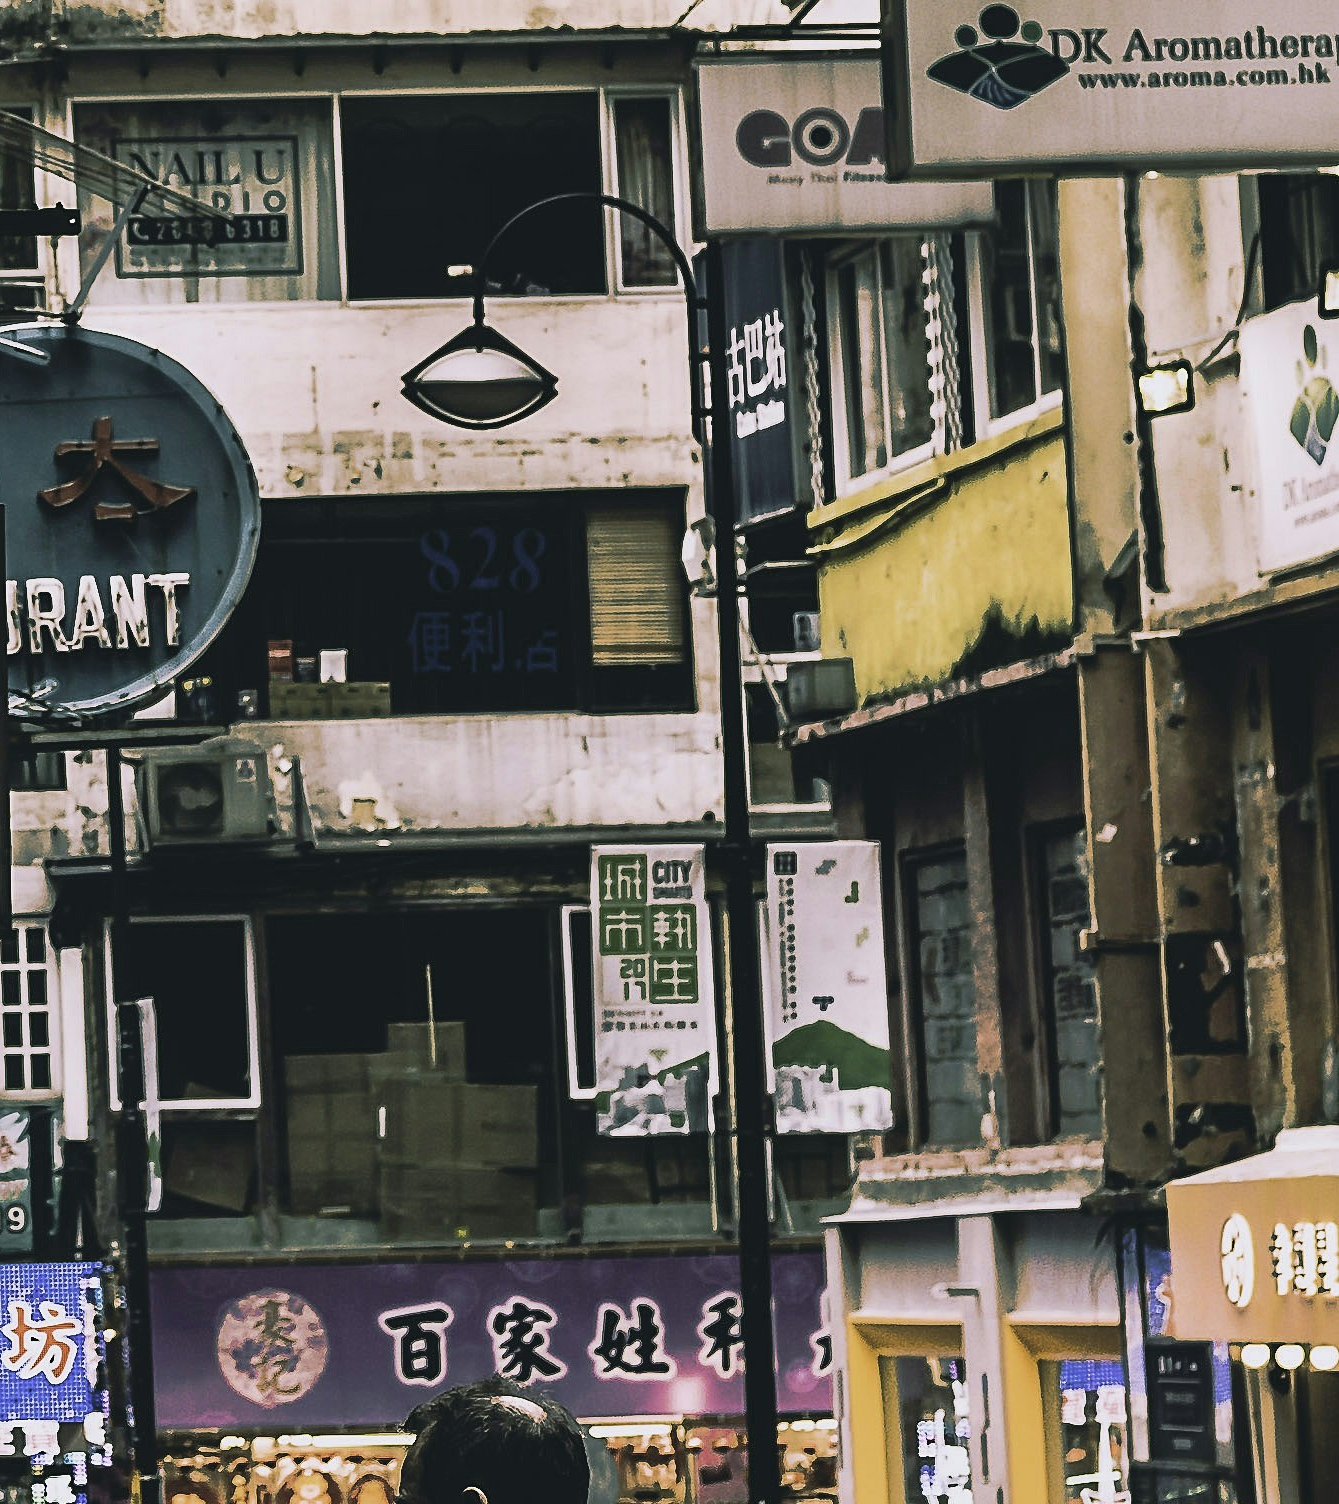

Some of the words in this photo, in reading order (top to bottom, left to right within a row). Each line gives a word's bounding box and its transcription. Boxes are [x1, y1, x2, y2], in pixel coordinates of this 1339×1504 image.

[1050, 28, 1109, 64] DK
[1078, 63, 1331, 90] www.aroma.com.hk
[130, 150, 241, 186] NAIL
[253, 149, 286, 186] U
[418, 527, 550, 594] 828
[652, 860, 693, 885] CITY
[381, 1294, 833, 1387] 百家姓
